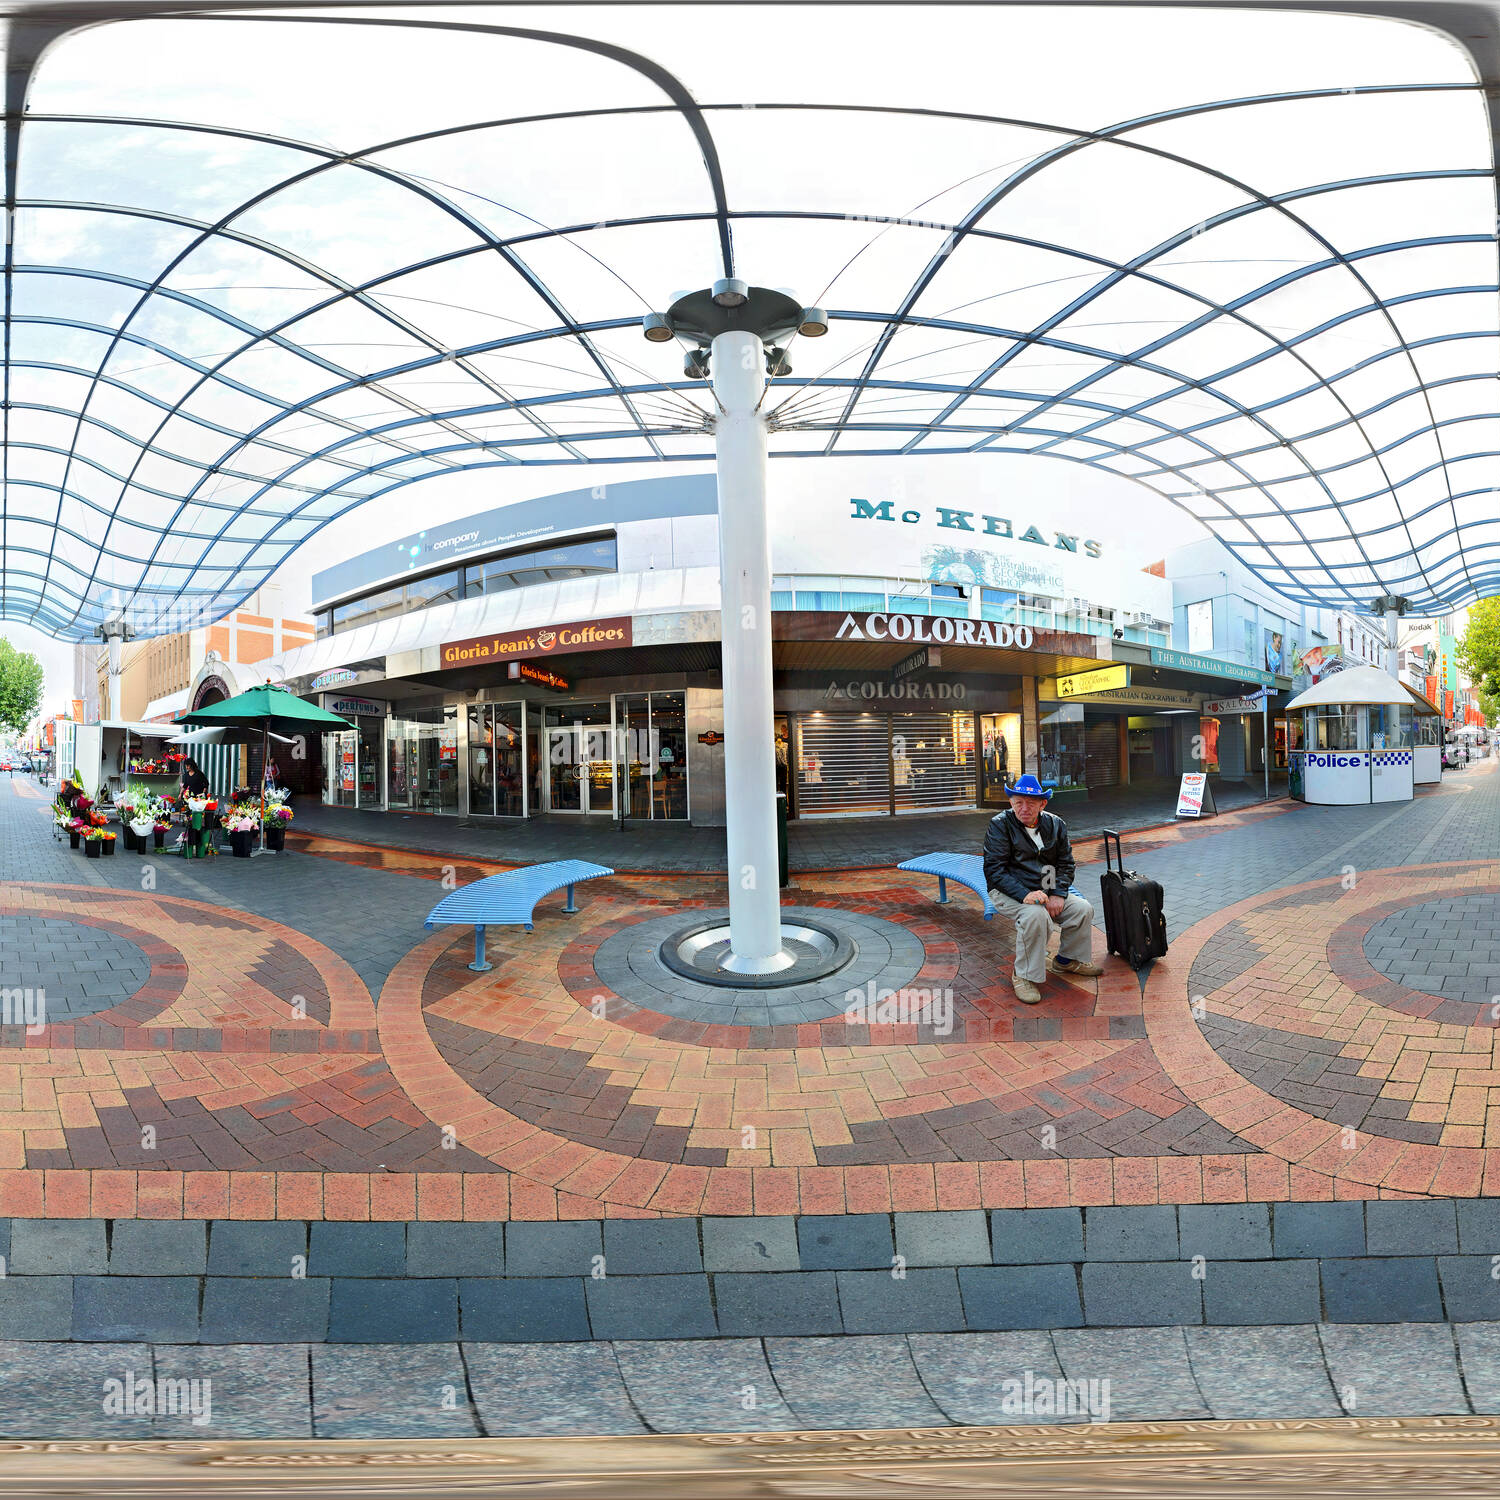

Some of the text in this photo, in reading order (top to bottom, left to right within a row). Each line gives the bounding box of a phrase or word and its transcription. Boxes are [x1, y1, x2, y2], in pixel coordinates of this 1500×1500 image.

[498, 533, 515, 543] People
[516, 526, 554, 537] Development
[865, 613, 1033, 649] COLORADO
[1408, 623, 1432, 631] Kodak
[445, 627, 624, 662] Gloria Jean's Coffees
[1157, 651, 1273, 682] THE AUSTRALIAN GEOGRAPHIC SHOP
[846, 681, 966, 700] COLORADO
[1097, 690, 1139, 700] AUSTRALIAN
[1141, 692, 1177, 702] GEOGRAPHIC
[1308, 753, 1361, 767] Police
